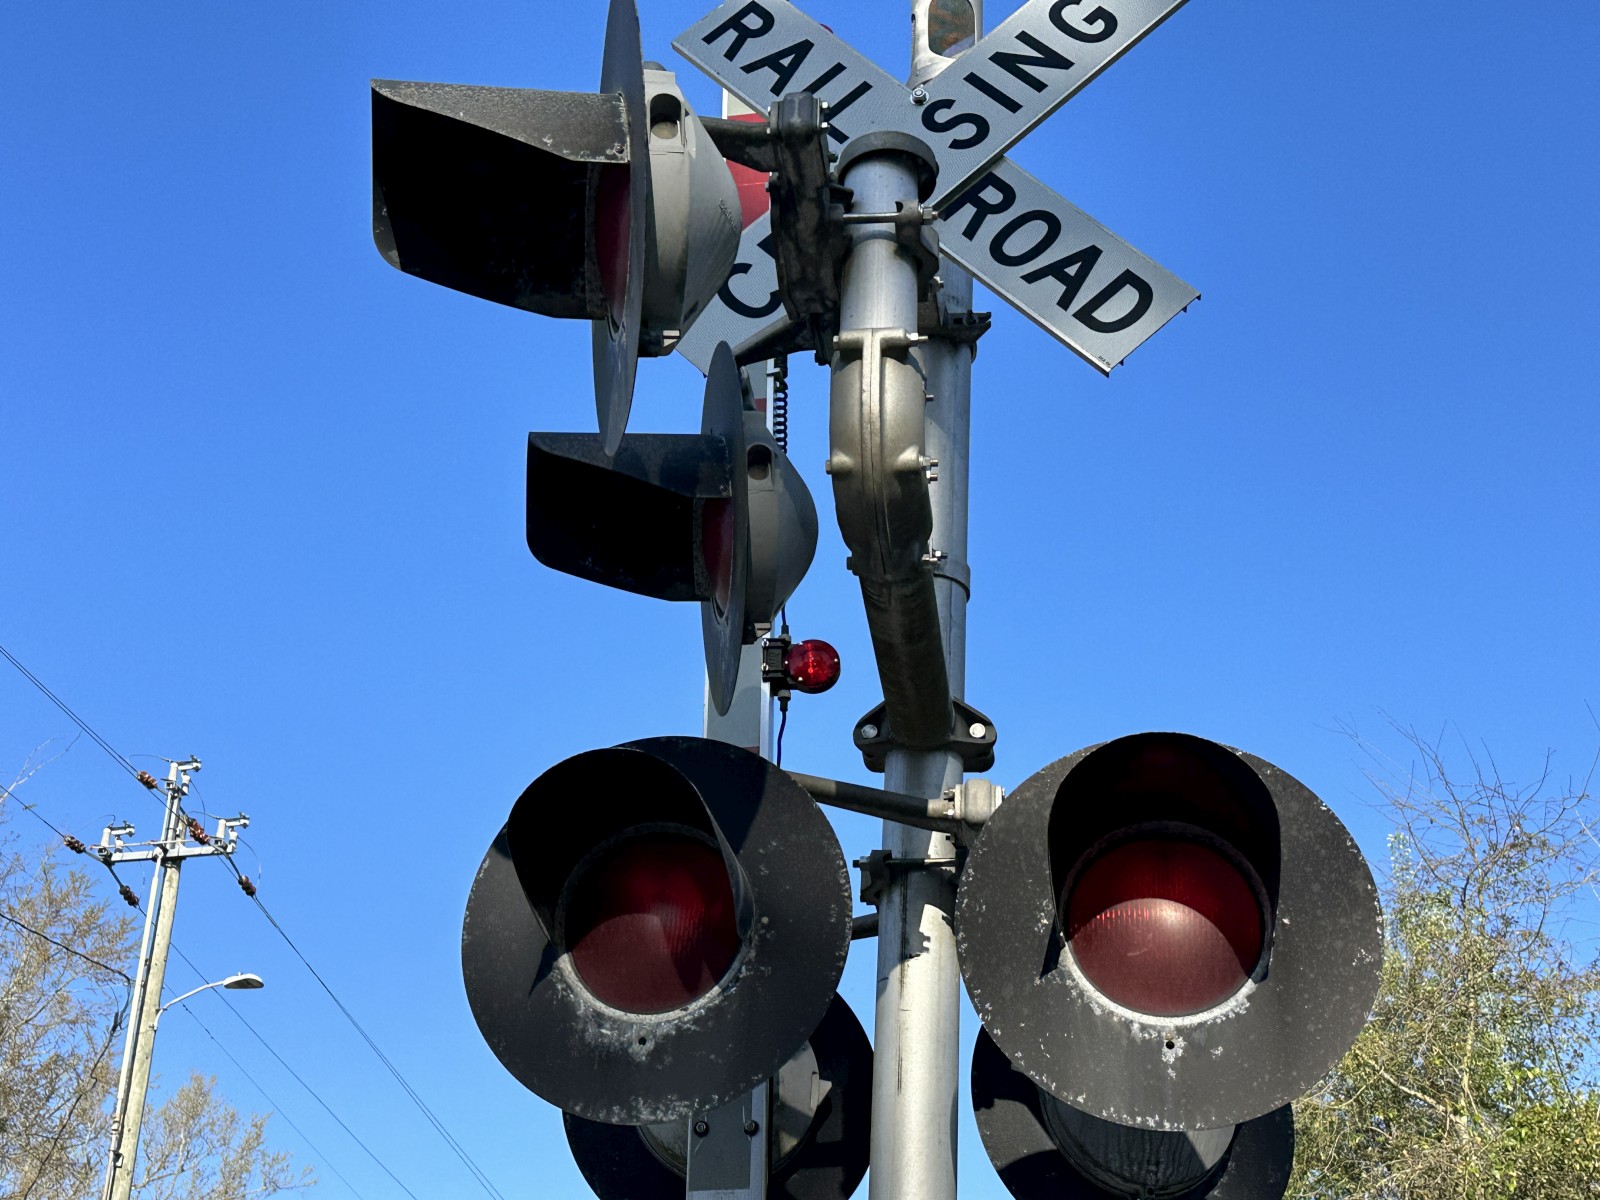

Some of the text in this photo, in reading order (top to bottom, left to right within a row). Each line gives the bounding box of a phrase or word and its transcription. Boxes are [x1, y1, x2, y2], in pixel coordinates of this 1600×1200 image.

[702, 0, 873, 144] RAIL
[938, 171, 1153, 333] ROAD
[922, 0, 1118, 149] SING
